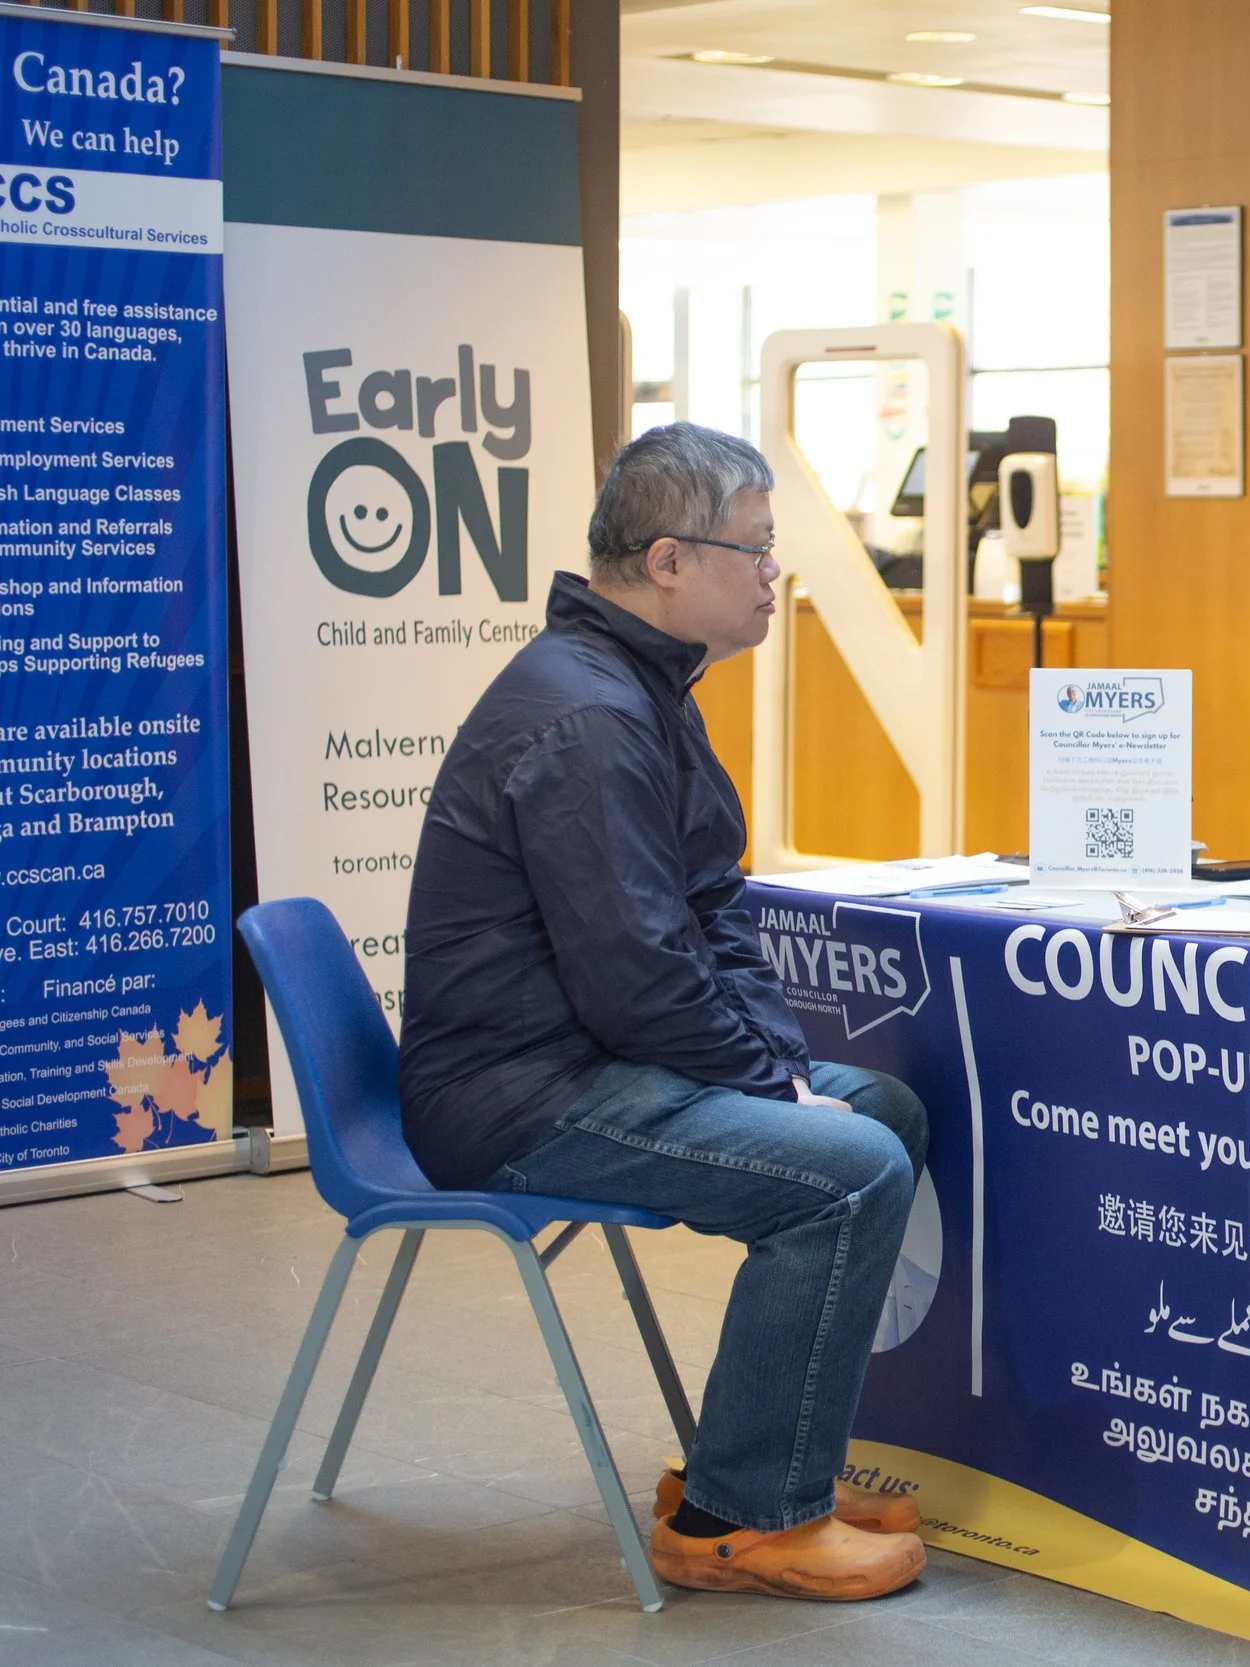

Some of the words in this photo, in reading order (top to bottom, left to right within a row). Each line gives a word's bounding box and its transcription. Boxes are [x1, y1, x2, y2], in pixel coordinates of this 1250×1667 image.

[13, 51, 186, 105] Canada?
[22, 118, 64, 148] We
[71, 130, 117, 152] can
[123, 127, 180, 165] help
[0, 172, 76, 215] CS
[43, 221, 142, 243] Crosscultural
[147, 229, 208, 245] Services
[44, 300, 77, 316] and
[82, 299, 117, 317] free
[123, 302, 218, 322] assistance
[14, 324, 55, 337] over
[59, 319, 81, 337] 30
[87, 323, 182, 345] languages,
[3, 341, 56, 358] thrive
[61, 343, 79, 359] in
[84, 345, 157, 362] Canada.
[303, 344, 531, 460] Early
[50, 416, 125, 434] Services
[102, 451, 174, 468] Services
[24, 485, 109, 505] Language
[115, 485, 181, 501] Classes
[58, 519, 91, 535] and
[96, 518, 173, 535] Referrals
[307, 437, 529, 603] ON
[81, 539, 155, 555] Services
[48, 578, 81, 594] and
[86, 576, 183, 593] Information
[30, 634, 62, 650] and
[68, 633, 138, 652] Support
[143, 634, 160, 648] to
[317, 621, 366, 646] Child
[373, 621, 406, 646] and
[414, 619, 473, 648] Family
[479, 620, 538, 644] Centre
[24, 655, 121, 674] Supporting
[126, 652, 205, 671] Refugees
[1087, 682, 1122, 690] JAMAAL
[1085, 692, 1155, 709] MYERS
[34, 716, 132, 740] available
[138, 713, 200, 735] onsite
[1040, 730, 1057, 738] Scan
[1059, 730, 1071, 738] the
[1073, 731, 1084, 739] QR
[1086, 731, 1105, 739] Code
[1107, 731, 1129, 739] below
[1141, 731, 1156, 741] sign
[325, 729, 445, 760] Malvern
[1053, 740, 1090, 748] Councillor
[1119, 741, 1166, 749] e-Newsletter
[81, 746, 177, 770] locations
[20, 777, 164, 805] Scarborough,
[20, 813, 61, 836] and
[68, 810, 175, 836] Brampton
[6, 915, 66, 936] Court:
[79, 900, 209, 929] 416.757.7010
[758, 907, 831, 936] JAMAAL
[29, 937, 79, 960] East:
[85, 924, 215, 955] 416.266.7200
[759, 932, 907, 998] MYERS
[43, 974, 115, 998] Financé
[122, 974, 155, 995] par:
[786, 986, 838, 1002] COUNCILLOR
[51, 1007, 108, 1023] Citizenship
[111, 1003, 151, 1017] Canada
[818, 1003, 841, 1015] NORTH
[31, 1118, 77, 1132] Charities
[1011, 1090, 1099, 1139] Come
[1108, 1114, 1190, 1157] meet
[32, 1145, 70, 1158] Toronto
[1071, 1361, 1192, 1413] உங்கள்
